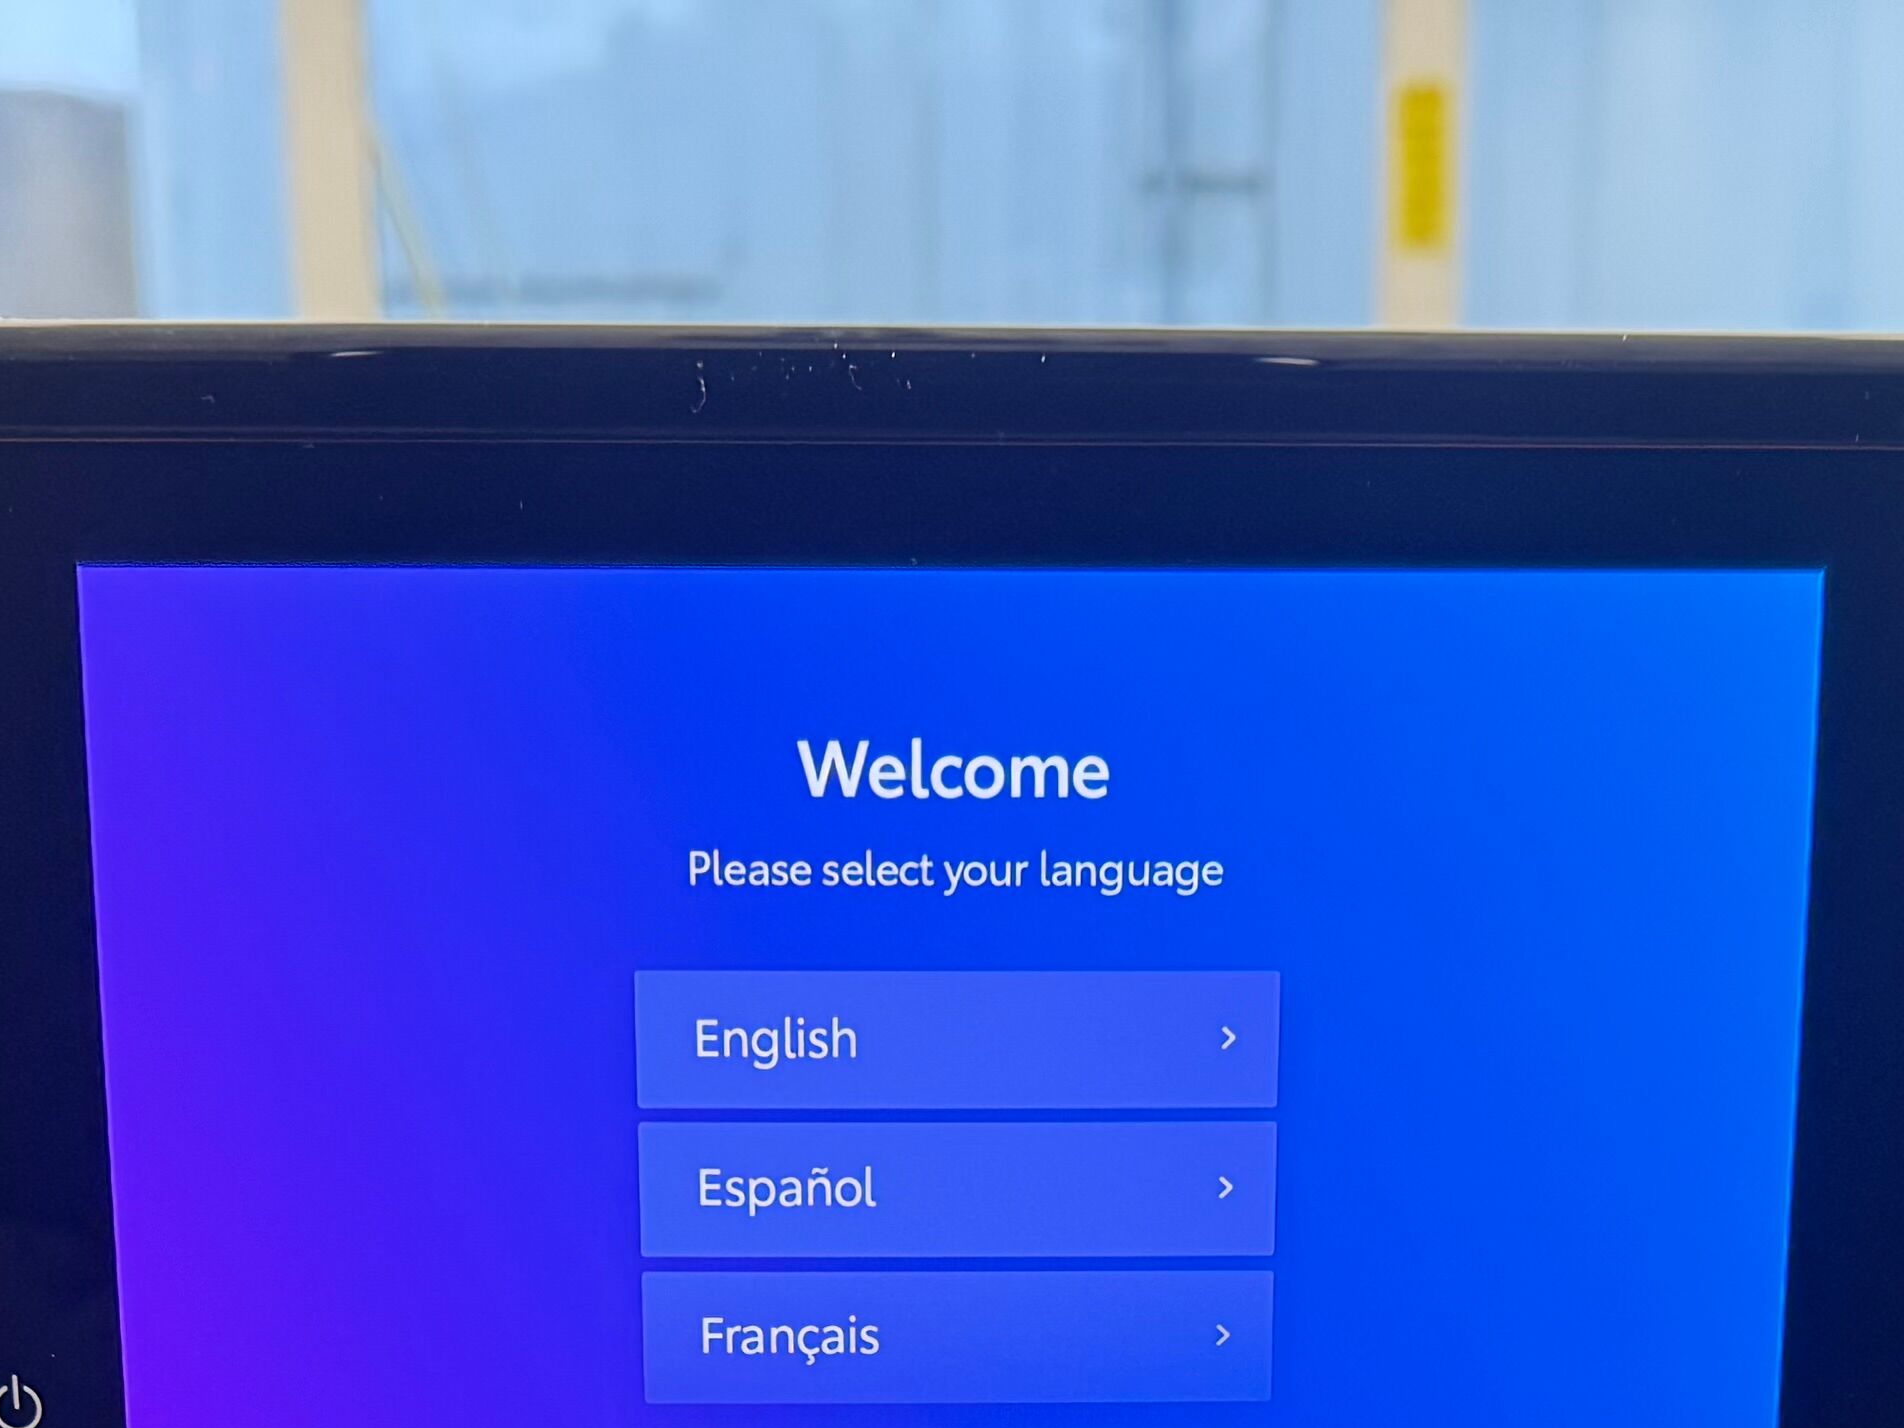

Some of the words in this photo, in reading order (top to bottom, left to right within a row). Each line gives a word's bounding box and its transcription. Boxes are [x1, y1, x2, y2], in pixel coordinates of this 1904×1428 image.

[797, 737, 1110, 800] Welcome
[689, 849, 812, 888] Please
[822, 849, 935, 888] select
[943, 860, 1030, 897] your
[1040, 850, 1225, 898] language
[695, 1017, 858, 1071] English
[698, 1166, 877, 1217] Español
[701, 1314, 880, 1366] Français
